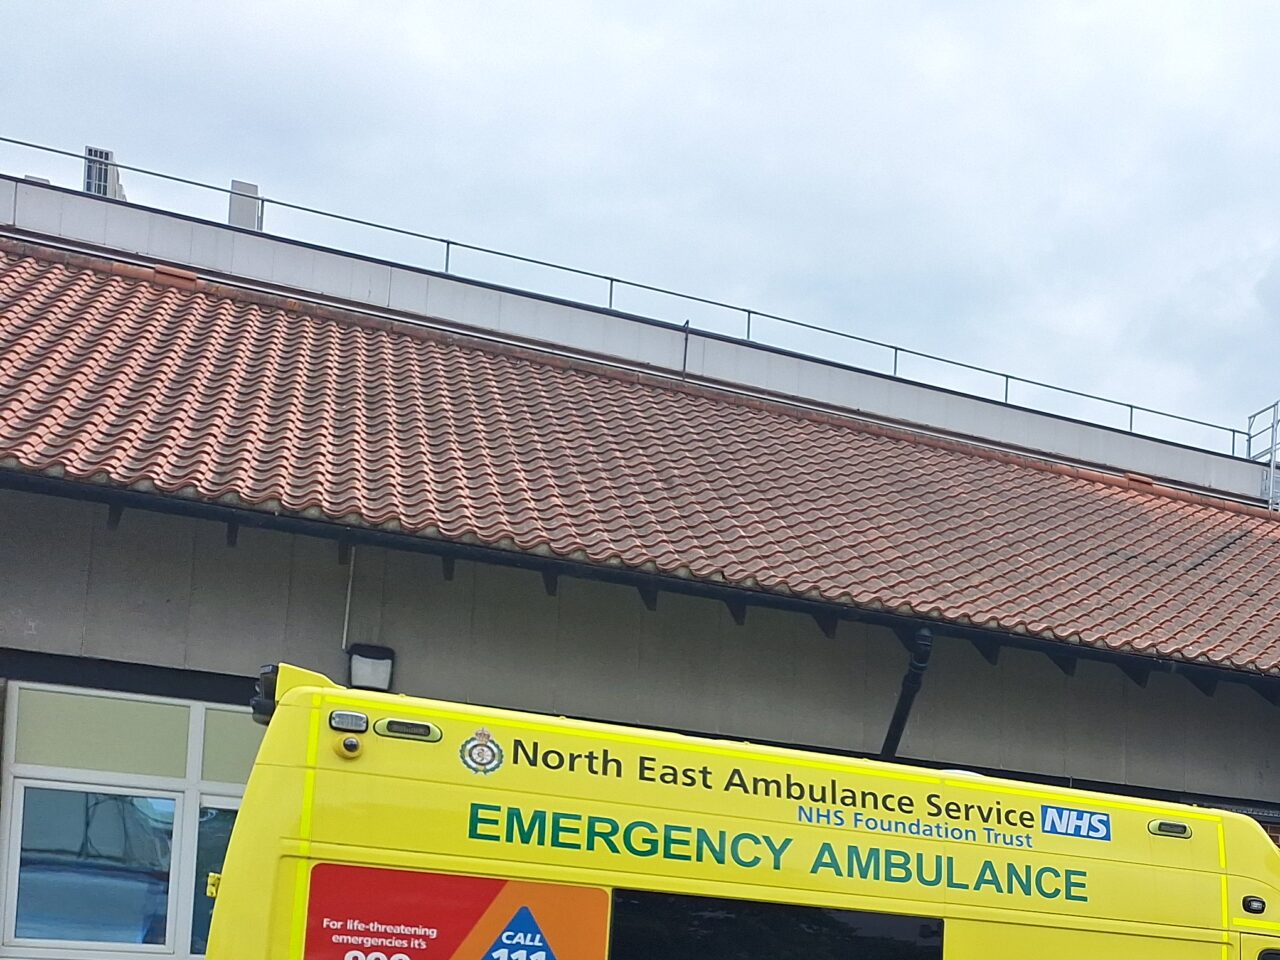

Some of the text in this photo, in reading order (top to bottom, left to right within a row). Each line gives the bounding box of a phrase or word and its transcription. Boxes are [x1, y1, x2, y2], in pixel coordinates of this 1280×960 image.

[512, 738, 1035, 828] North East Ambulance Service
[797, 804, 1033, 849] NHS Foundation Trust
[1042, 806, 1109, 839] NHS
[467, 801, 1088, 902] EMERGENCY AMBULANCE
[323, 918, 437, 939] For life-threatening
[332, 934, 427, 949] emergencies it's
[501, 931, 543, 946] CALL
